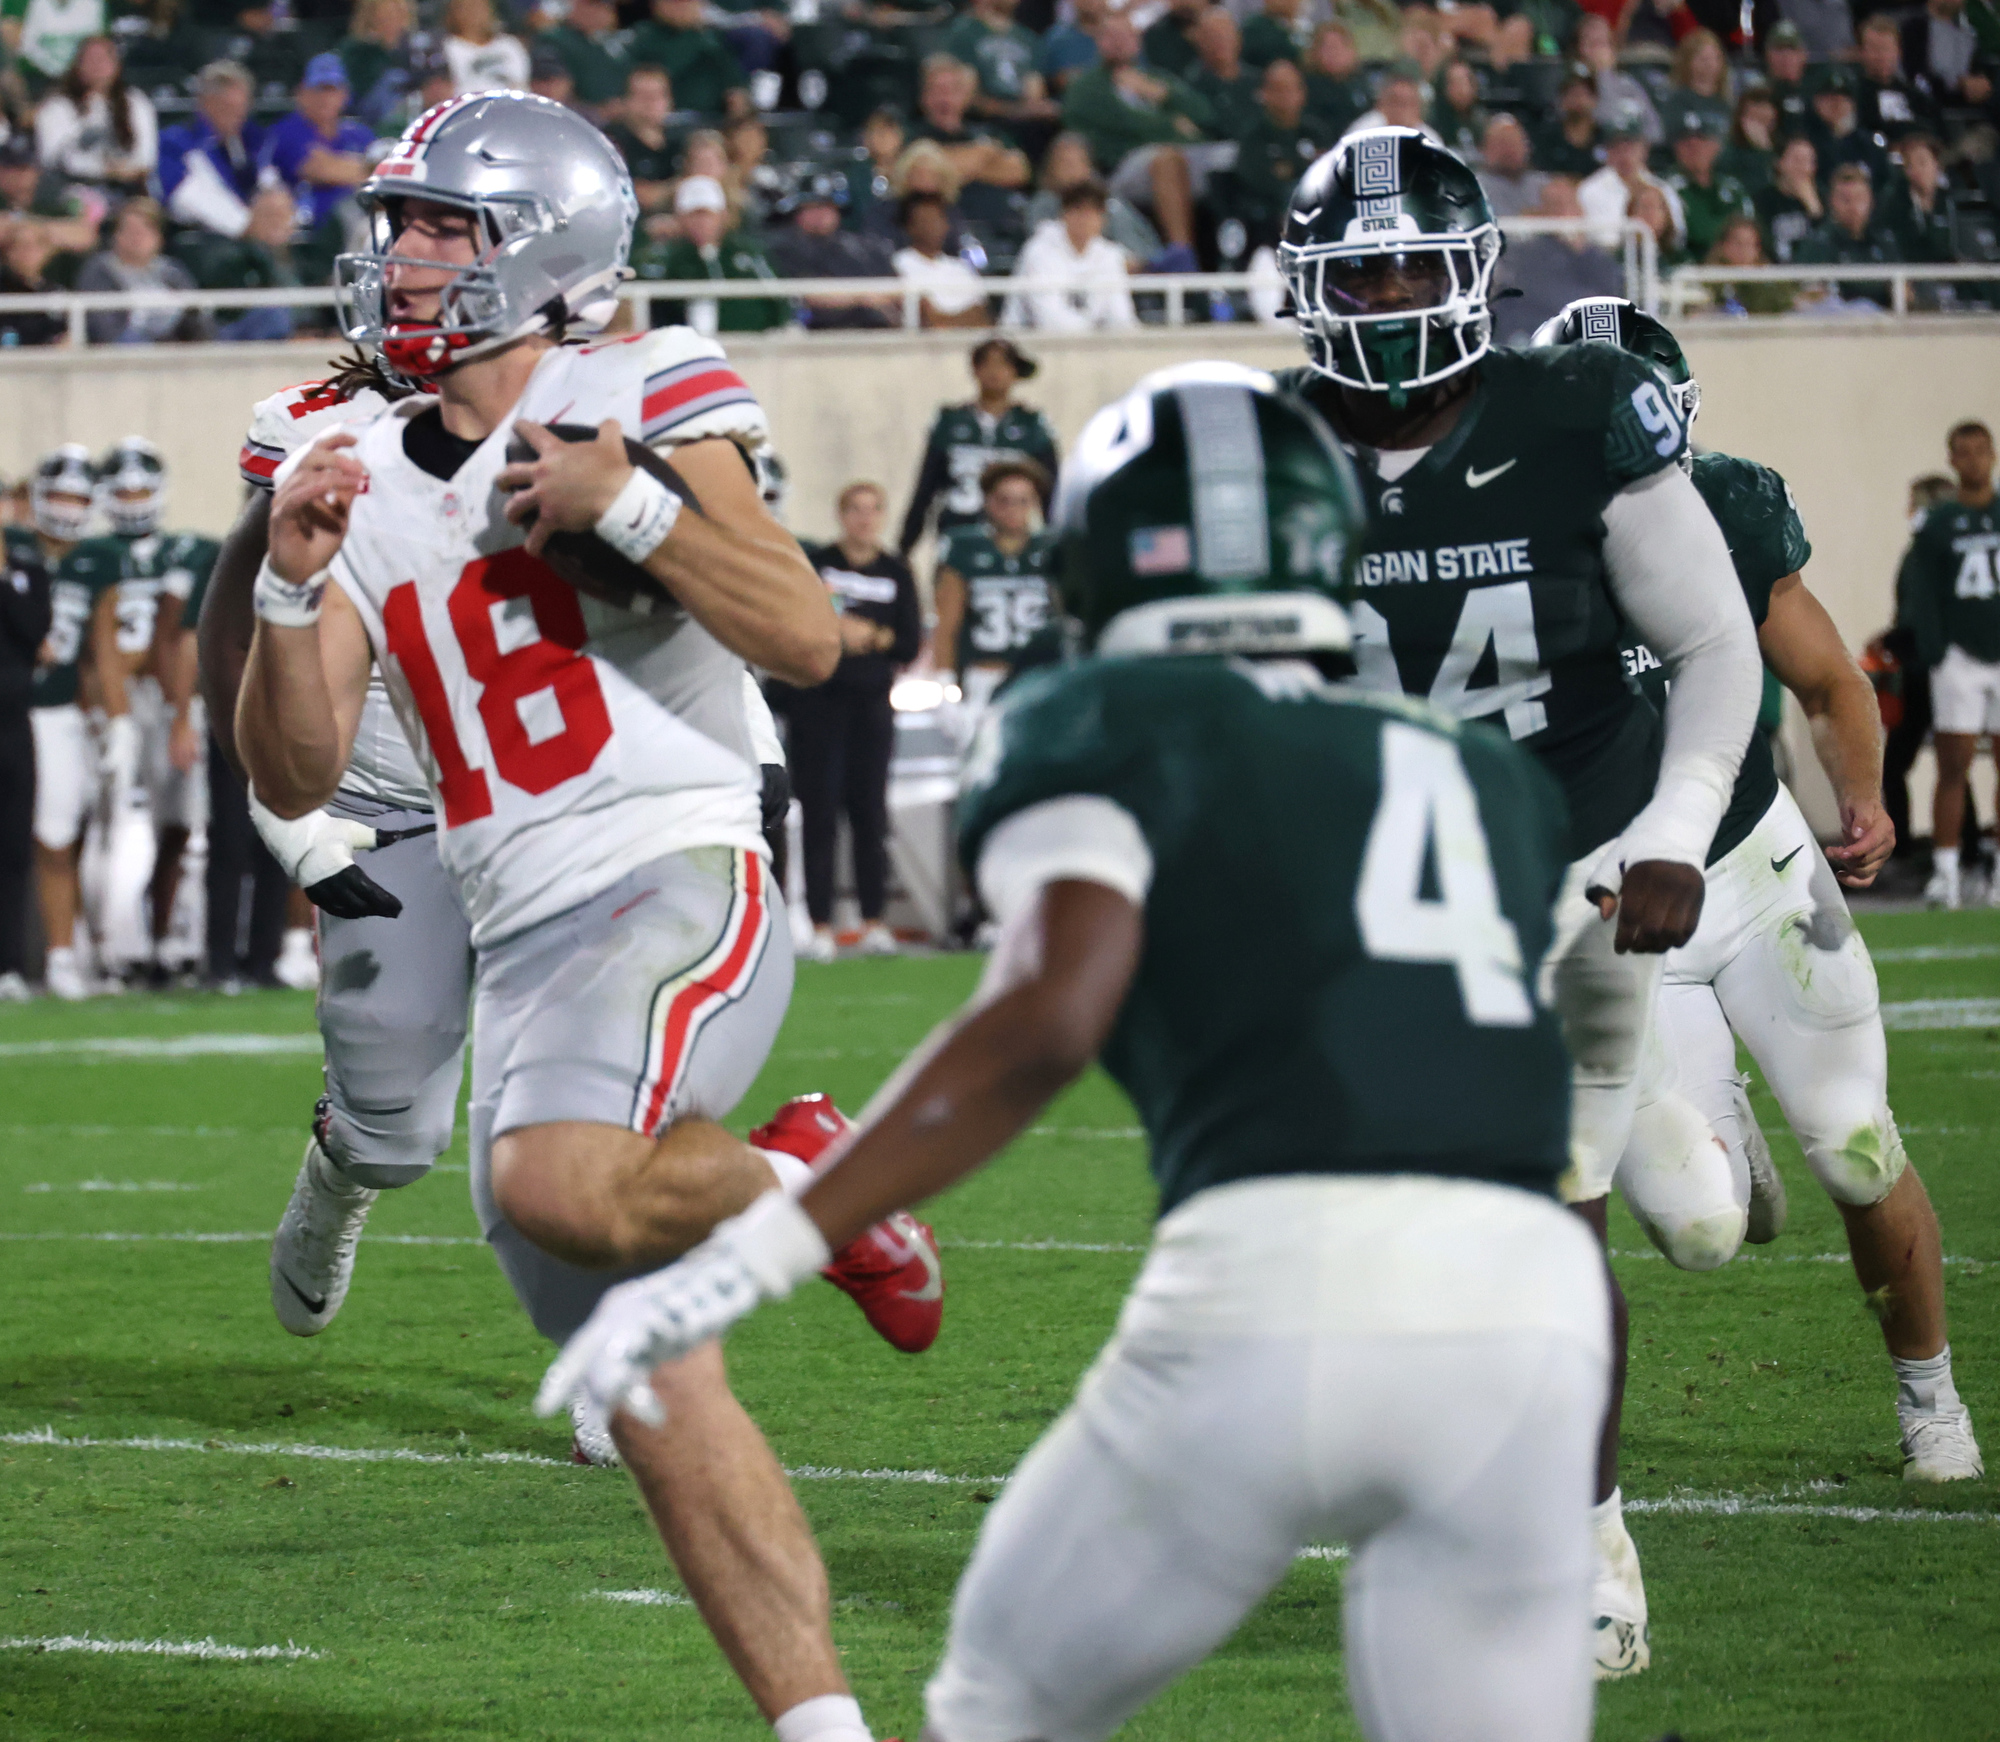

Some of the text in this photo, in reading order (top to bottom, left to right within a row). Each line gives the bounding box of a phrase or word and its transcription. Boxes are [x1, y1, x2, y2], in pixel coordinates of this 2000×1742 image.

[1361, 217, 1400, 233] STATE
[1435, 537, 1534, 581] STATE
[383, 544, 615, 831] 18
[1353, 718, 1536, 1029] 4
